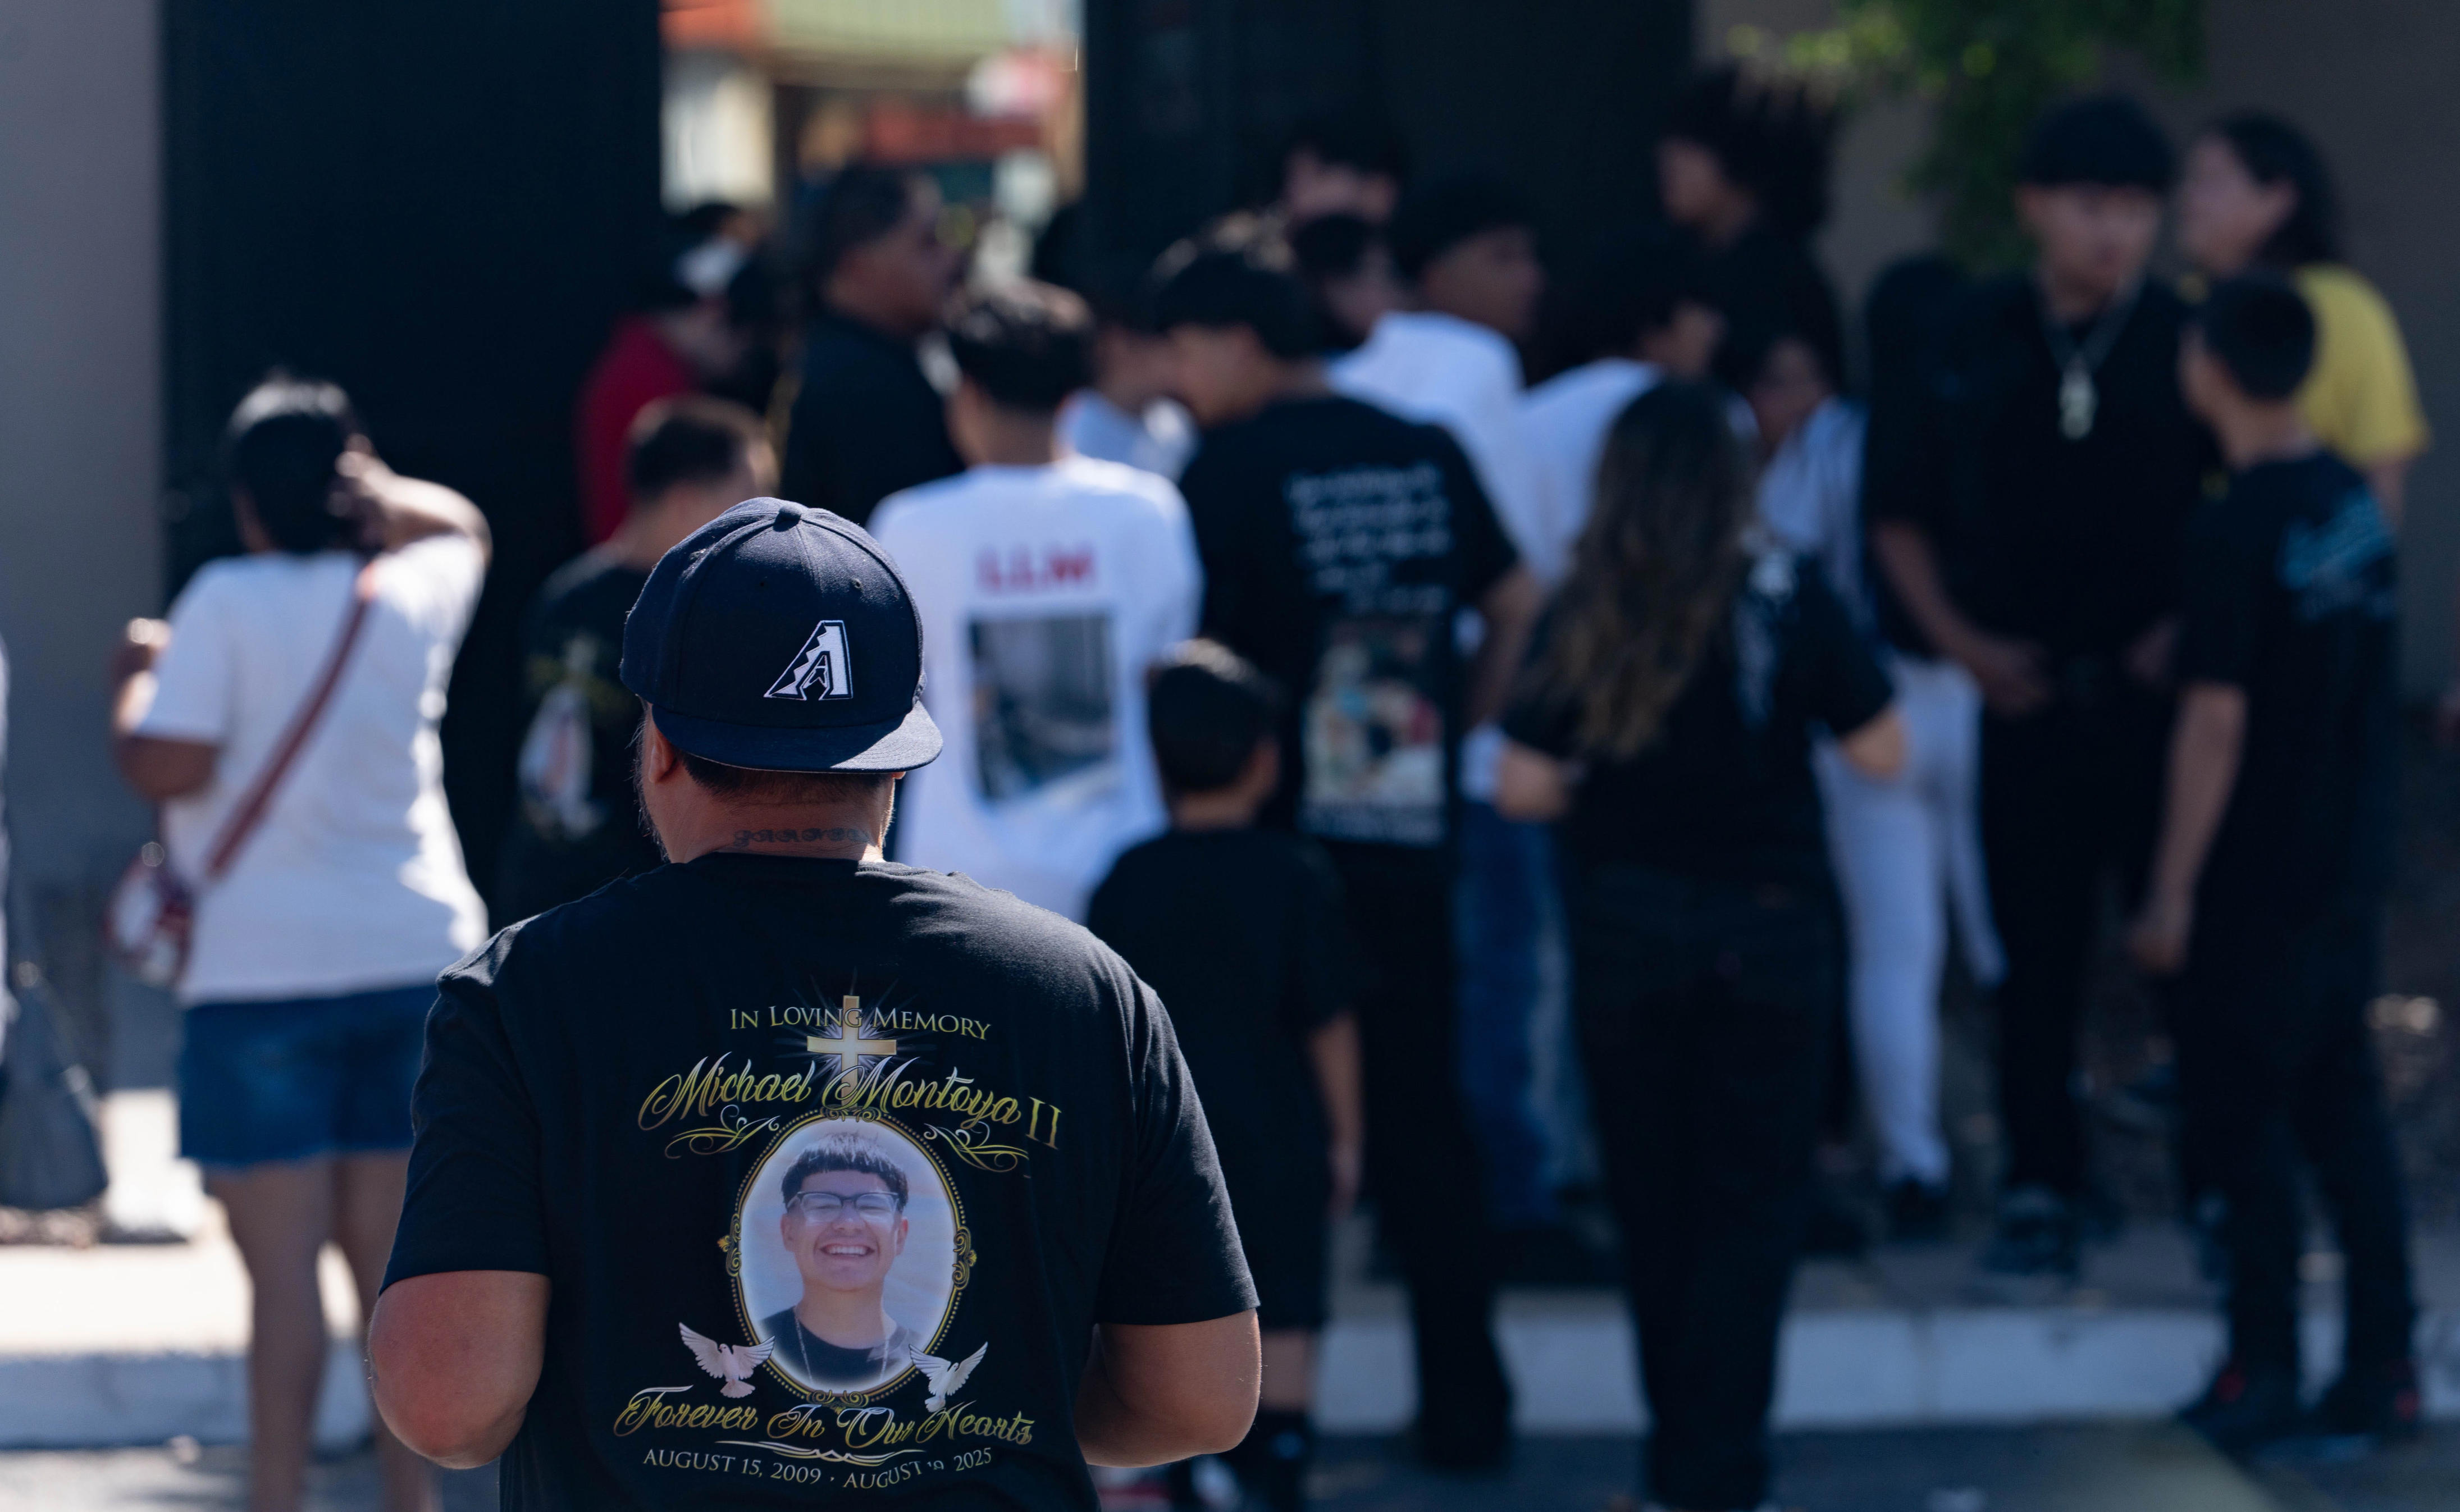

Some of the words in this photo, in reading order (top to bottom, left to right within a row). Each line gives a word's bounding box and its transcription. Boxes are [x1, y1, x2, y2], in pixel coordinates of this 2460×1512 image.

[770, 1006, 862, 1028] LOVING
[873, 1007, 991, 1040] MEMORY
[638, 1051, 816, 1131] Michael
[821, 1056, 1021, 1130] Montoya
[1025, 1097, 1062, 1150] II
[613, 1385, 758, 1437] Forever
[767, 1404, 825, 1438] In
[837, 1406, 915, 1449] Our
[915, 1400, 1035, 1445] Hearts
[643, 1449, 736, 1472] AUGUST
[741, 1458, 762, 1478] 15,
[770, 1462, 821, 1484] 2009
[843, 1460, 923, 1488] AUGUST
[953, 1447, 991, 1471] 2025
